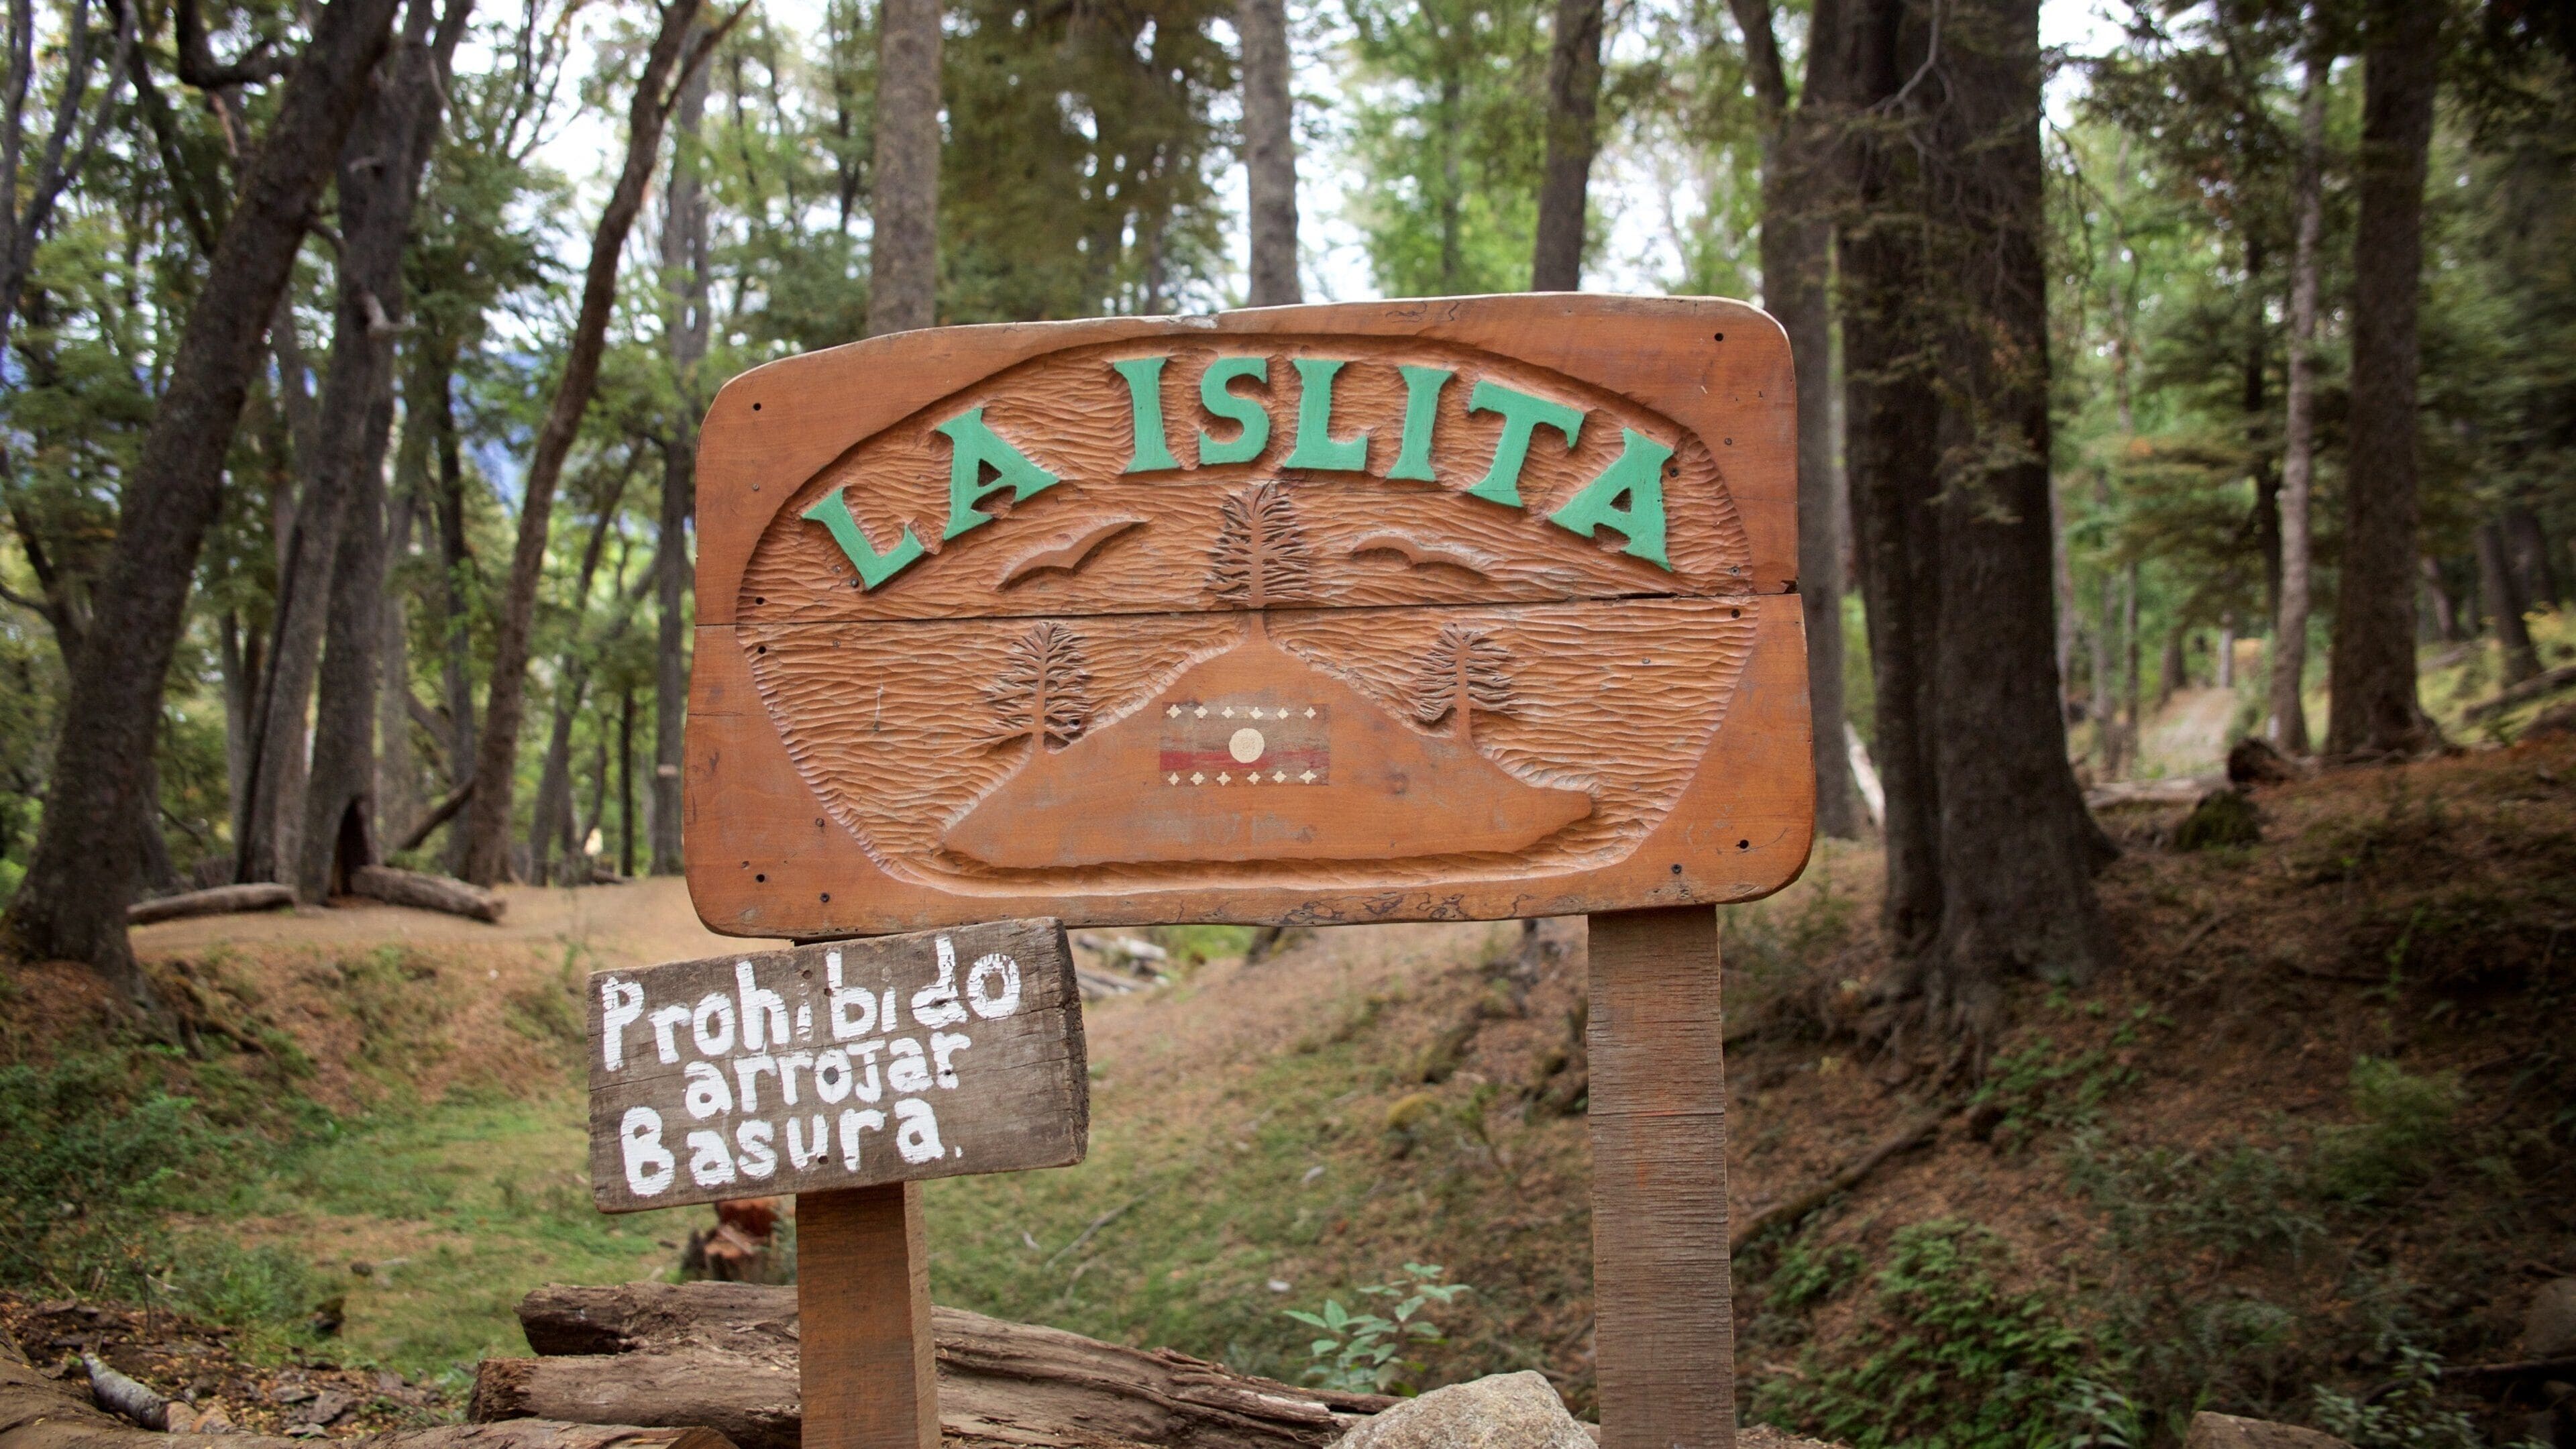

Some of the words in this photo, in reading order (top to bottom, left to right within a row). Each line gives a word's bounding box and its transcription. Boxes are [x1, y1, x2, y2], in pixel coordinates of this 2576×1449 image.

[802, 407, 1059, 591] LA
[1114, 357, 1674, 572] ISLITA
[601, 935, 1022, 1073] Prohibido
[619, 1097, 963, 1197] Basura.
